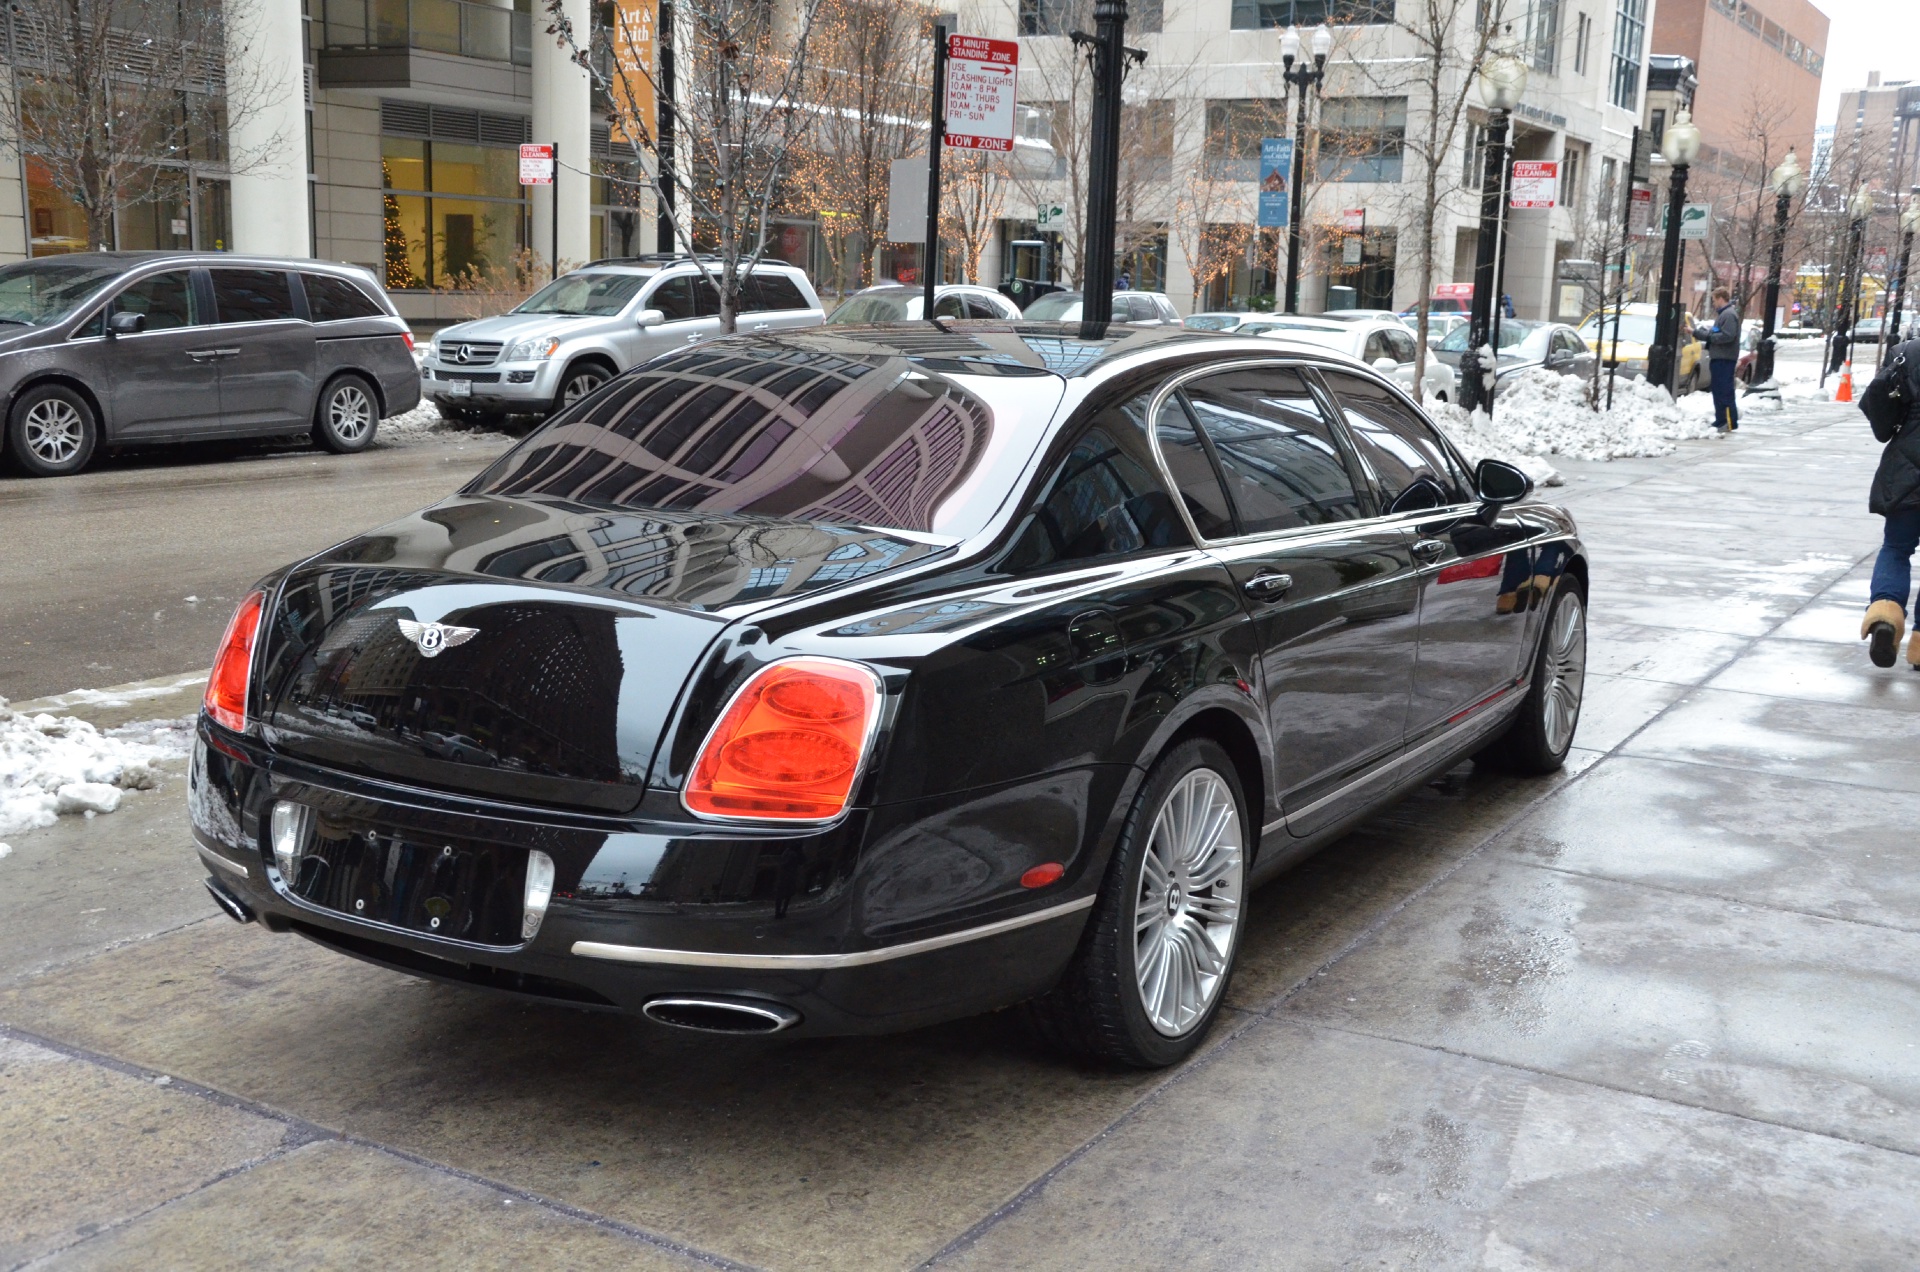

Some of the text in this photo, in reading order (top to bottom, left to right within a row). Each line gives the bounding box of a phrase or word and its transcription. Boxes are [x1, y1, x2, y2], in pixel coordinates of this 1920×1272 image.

[618, 7, 652, 24] Art &
[618, 24, 649, 43] Faith
[953, 37, 990, 50] 15 MINUTE
[952, 47, 1011, 62] STANDING ZONE
[952, 63, 966, 72] USE
[951, 72, 1013, 86] FLASHING LIGHTS
[960, 83, 972, 91] AM
[986, 86, 998, 94] PM
[950, 92, 967, 100] MON
[976, 94, 1000, 103] THURS
[949, 110, 962, 118] FRI
[969, 112, 984, 120] SUN
[948, 135, 1008, 150] TOW ZONE
[1264, 144, 1274, 152] Art
